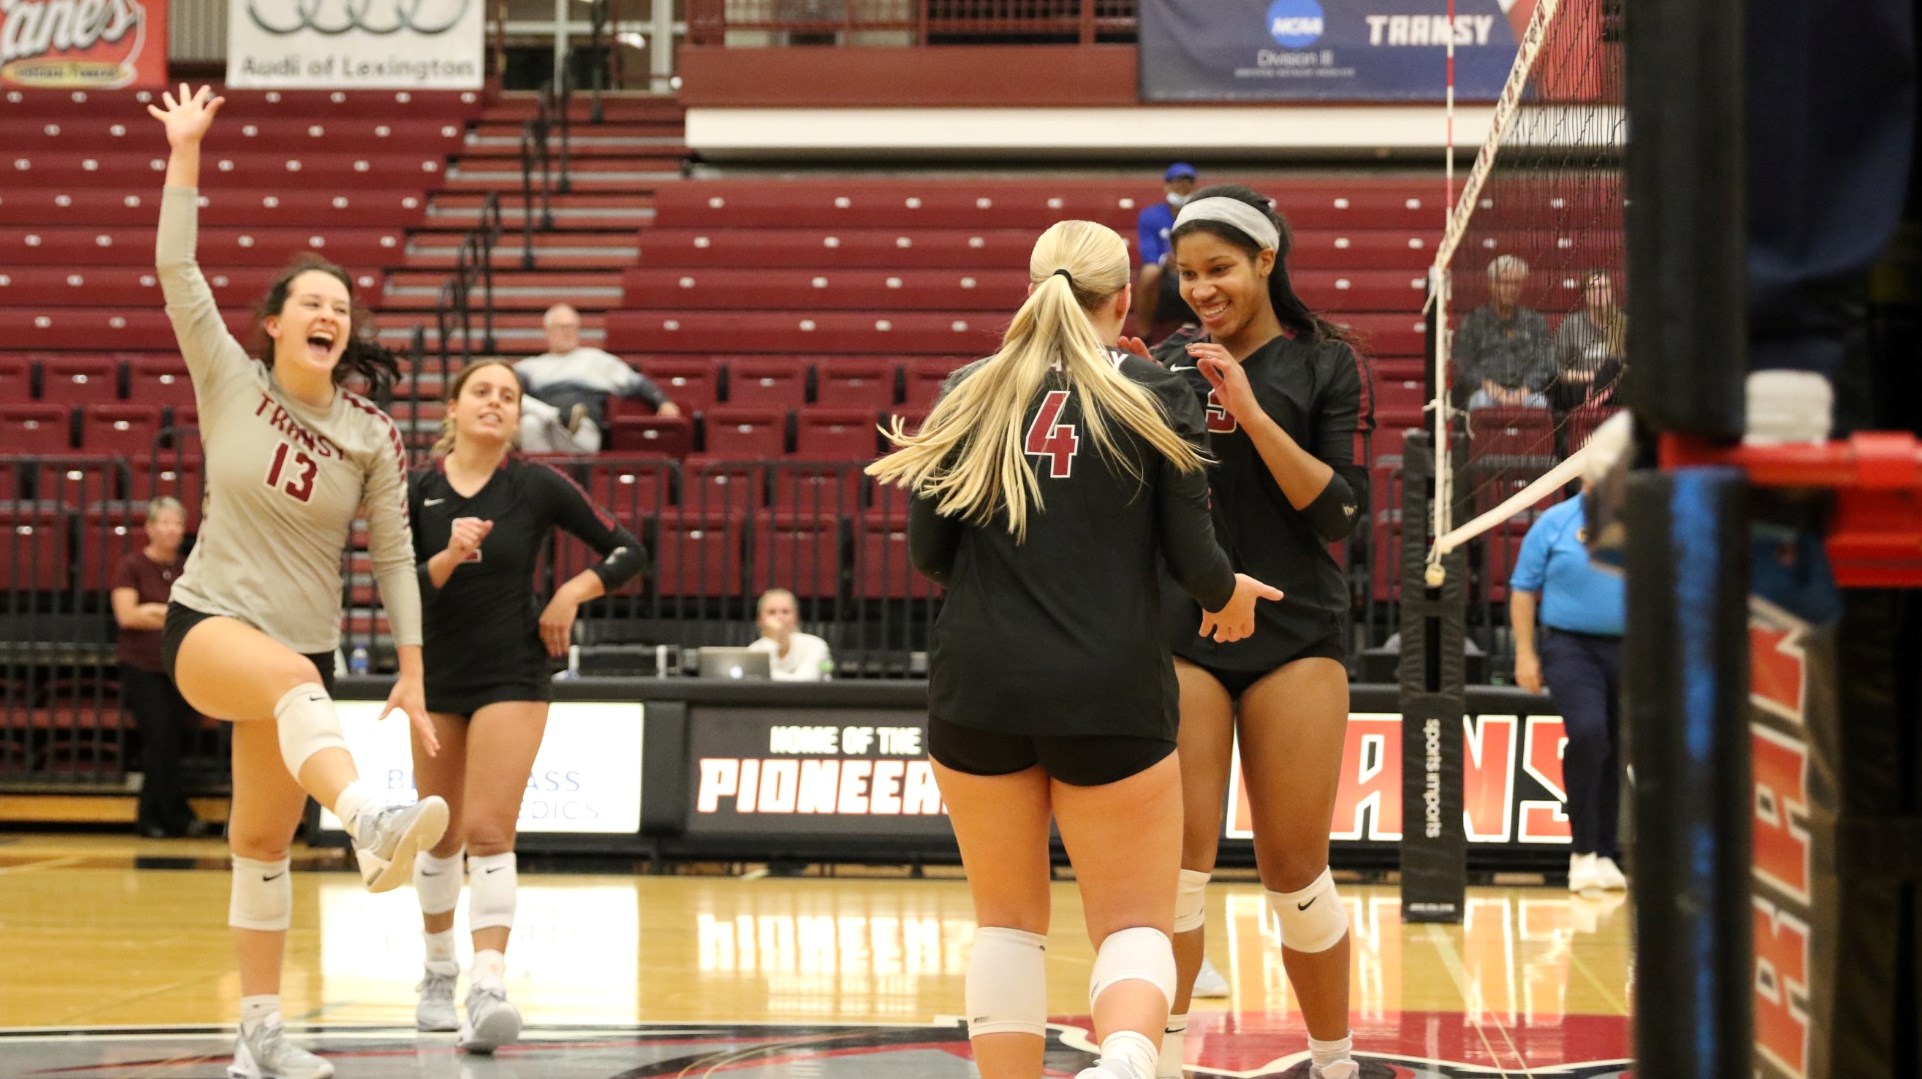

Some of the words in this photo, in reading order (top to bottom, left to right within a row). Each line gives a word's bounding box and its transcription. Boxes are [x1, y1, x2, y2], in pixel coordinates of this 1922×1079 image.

[1271, 16, 1325, 36] NCAA
[1365, 14, 1494, 46] TRANSY
[241, 55, 300, 76] Audi
[307, 54, 334, 76] of
[341, 54, 475, 80] Lexington
[1257, 49, 1318, 67] Division
[1024, 390, 1078, 479] 4
[264, 440, 319, 504] 13
[769, 726, 838, 755] HOME
[842, 726, 874, 755] OF
[876, 727, 922, 755] THE
[1422, 718, 1441, 773] sports
[697, 758, 950, 814] PIONEER
[1422, 775, 1441, 839] imports
